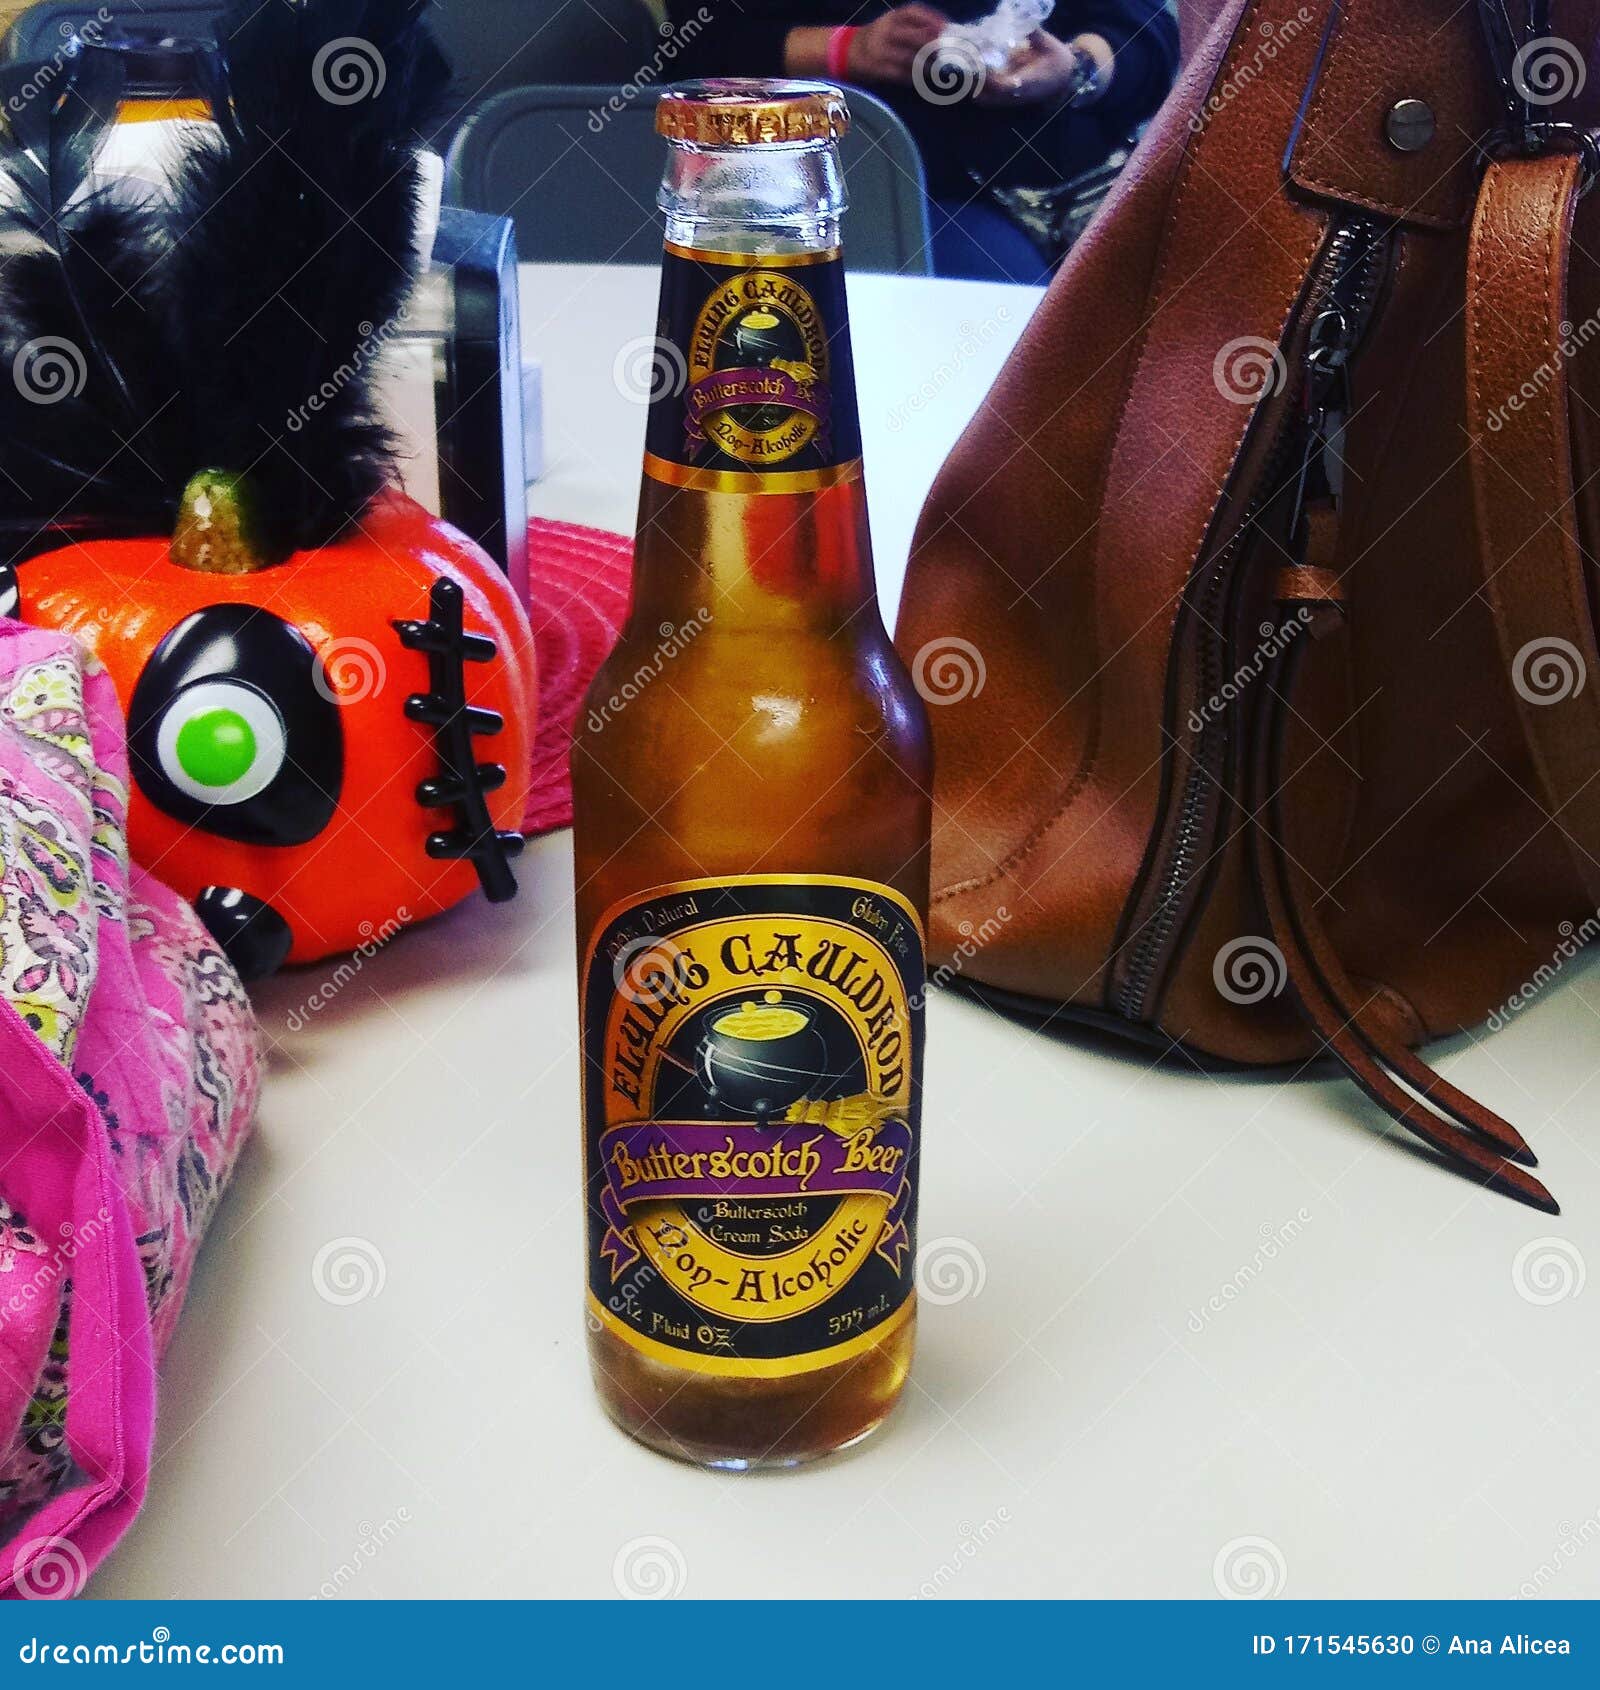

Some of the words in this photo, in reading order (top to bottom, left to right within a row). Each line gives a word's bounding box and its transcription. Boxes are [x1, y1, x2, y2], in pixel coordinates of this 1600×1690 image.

[612, 948, 710, 1108] FLYING
[720, 932, 905, 1098] CAULDRON
[611, 1134, 825, 1191] Butterscotch
[833, 1126, 904, 1175] Beer
[713, 1201, 808, 1219] Butterscotch
[710, 1224, 760, 1243] Cream
[766, 1224, 809, 1249] Soda
[647, 1217, 868, 1303] Non-Alcoholic
[648, 1311, 690, 1340] Fluid
[828, 1305, 863, 1336] 355
